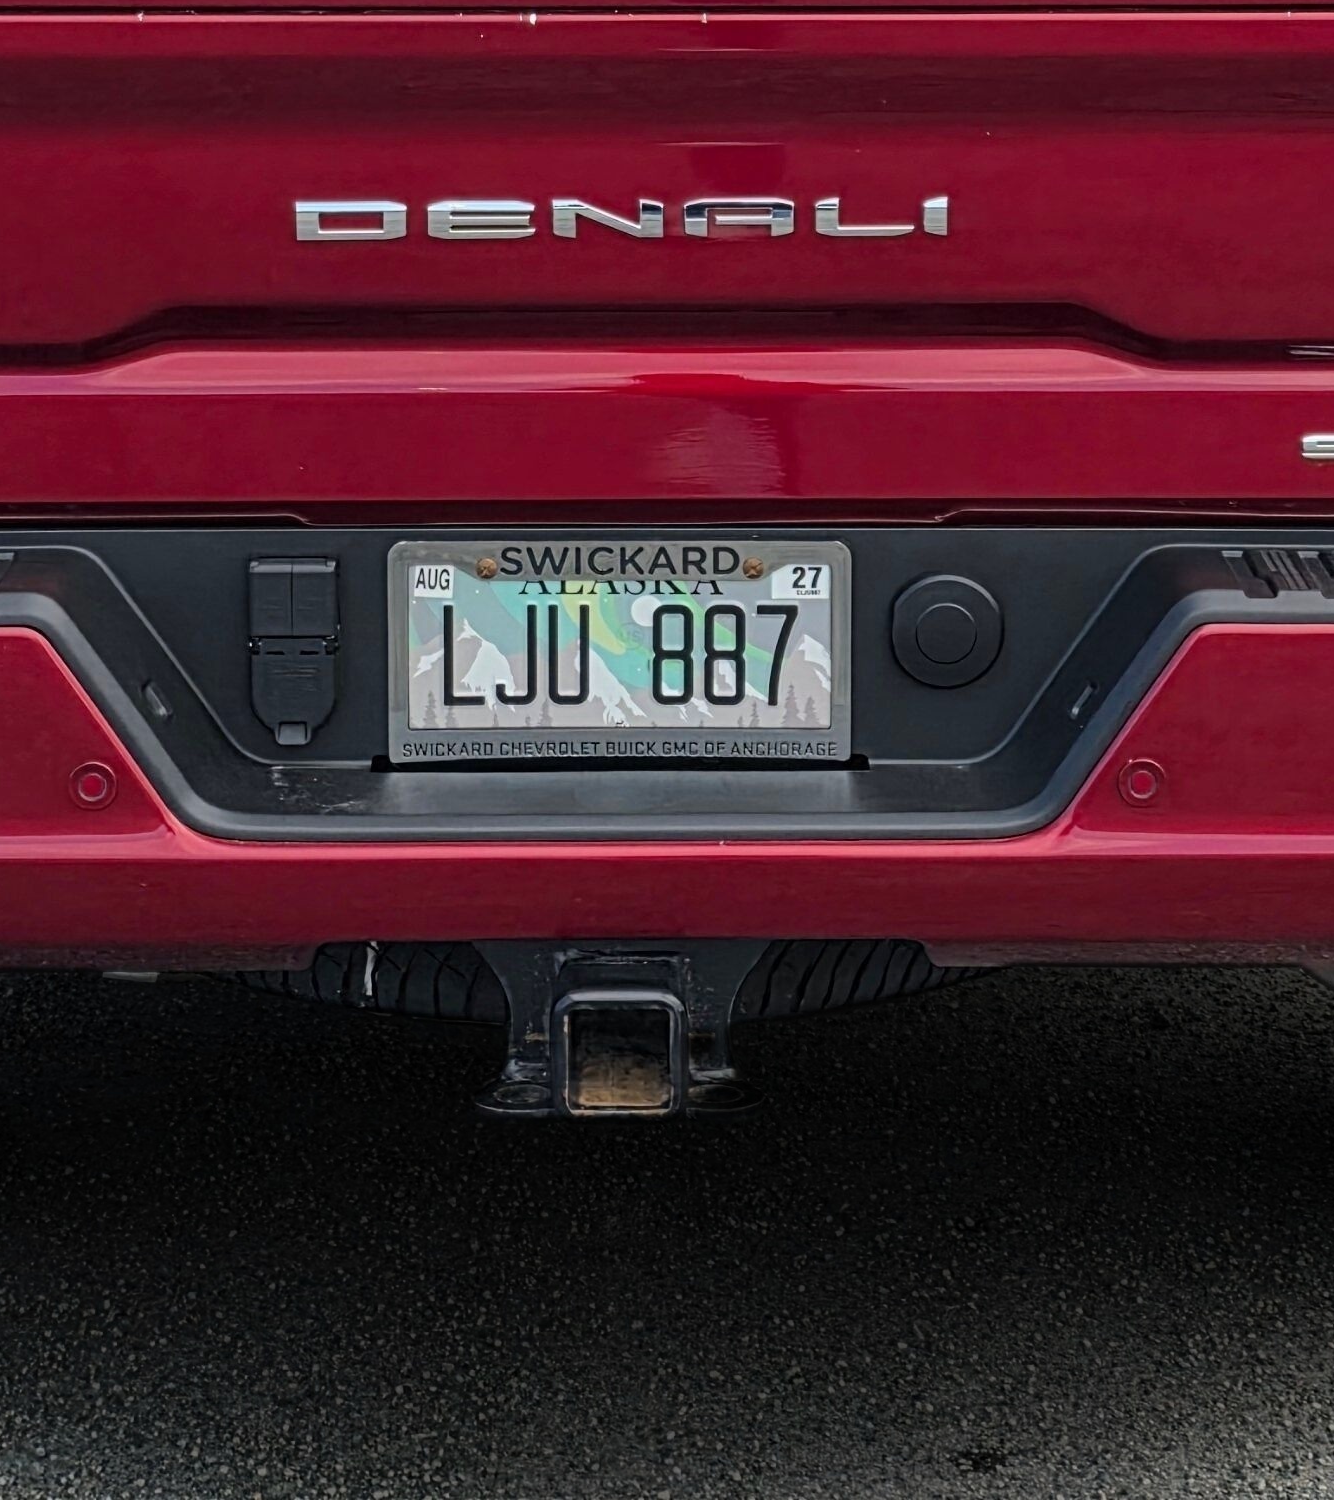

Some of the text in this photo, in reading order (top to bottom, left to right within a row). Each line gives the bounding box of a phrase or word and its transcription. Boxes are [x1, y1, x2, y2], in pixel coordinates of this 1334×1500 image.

[295, 195, 949, 241] DENALI
[500, 546, 740, 576] SWICKARD
[416, 568, 451, 591] AUG
[792, 566, 823, 589] 27
[443, 604, 799, 706] LJU 887
[402, 741, 838, 758] SWICKARD CHEVROLET BUICK GMC OF ANCHORAGE
